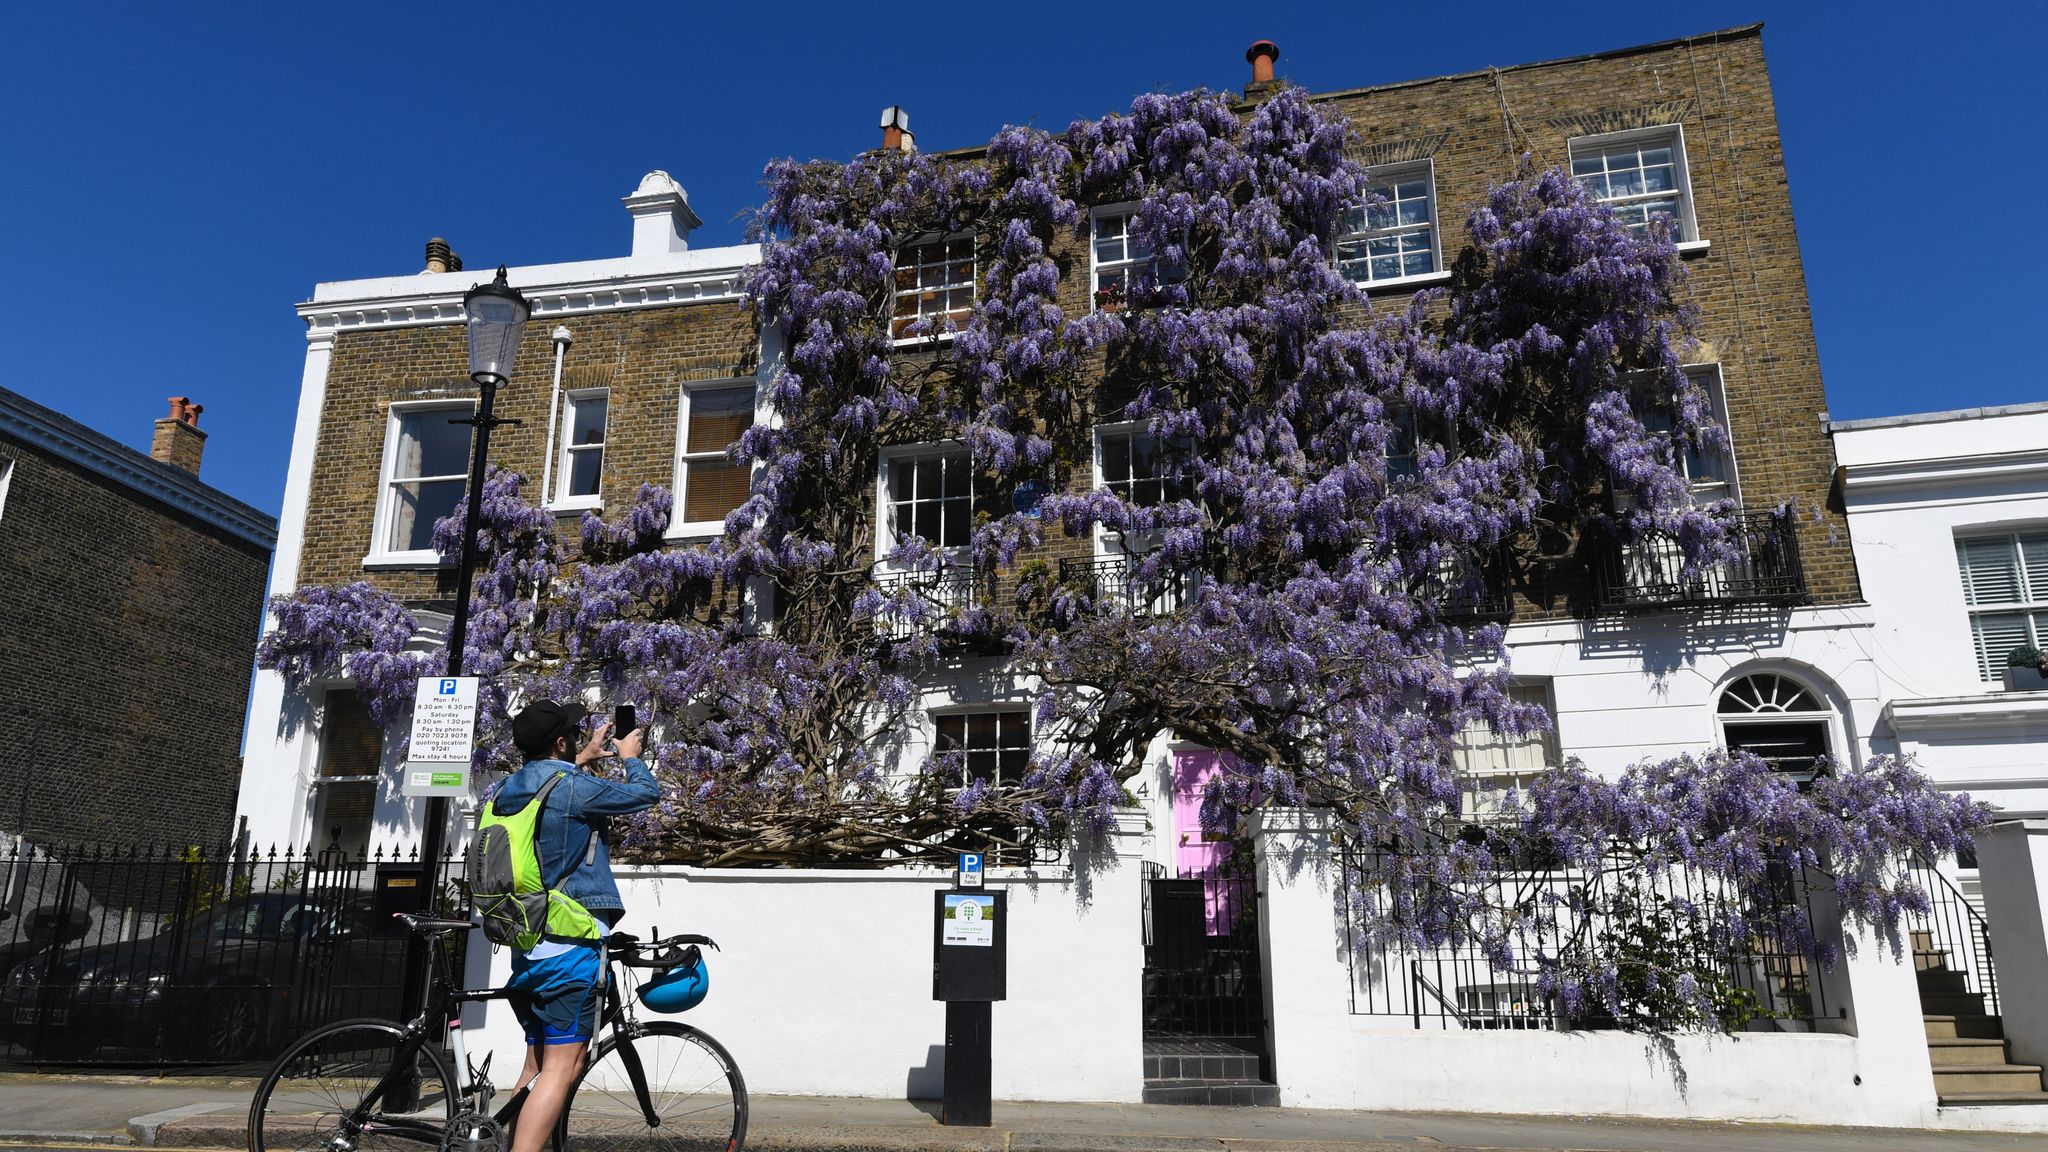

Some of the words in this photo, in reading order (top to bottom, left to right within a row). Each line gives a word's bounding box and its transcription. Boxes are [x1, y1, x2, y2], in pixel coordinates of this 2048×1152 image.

[443, 681, 454, 693] P
[1136, 780, 1149, 797] 4
[965, 855, 978, 871] P
